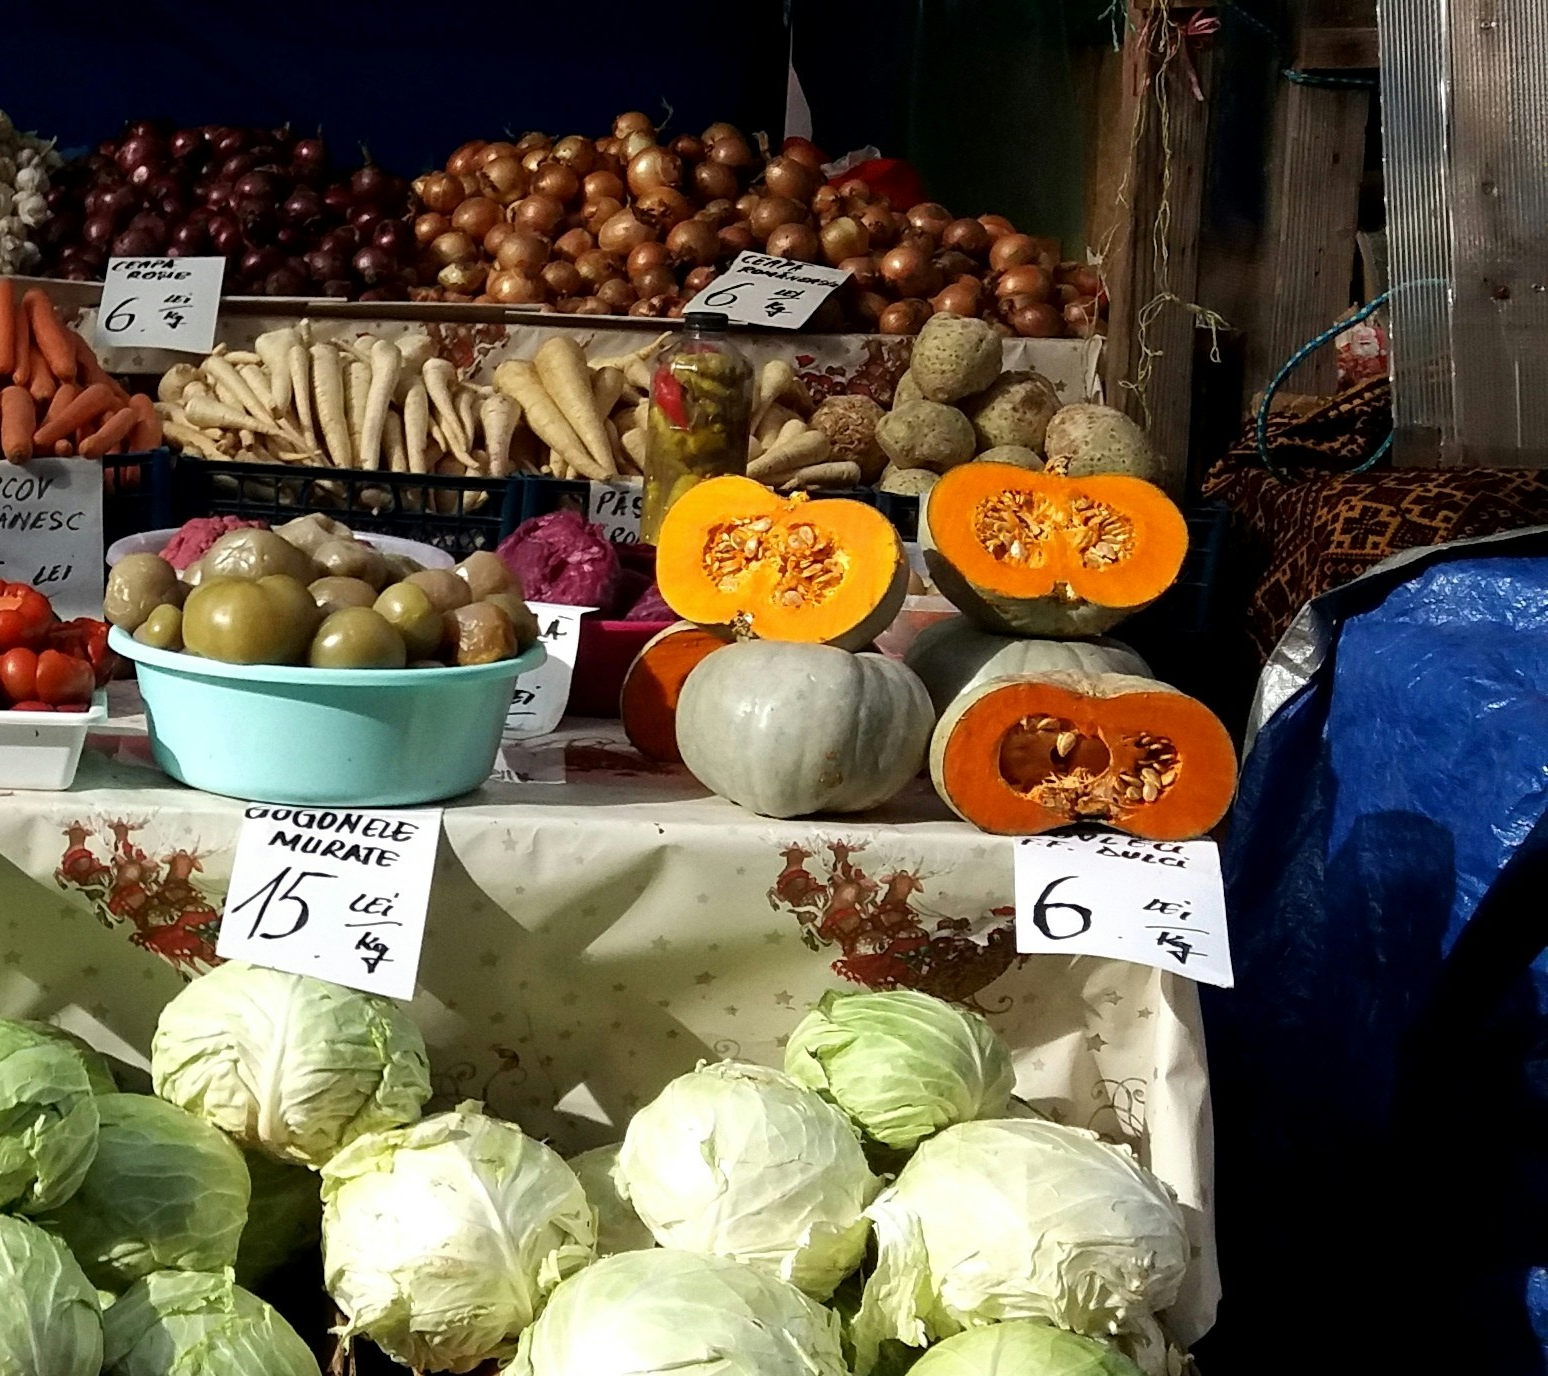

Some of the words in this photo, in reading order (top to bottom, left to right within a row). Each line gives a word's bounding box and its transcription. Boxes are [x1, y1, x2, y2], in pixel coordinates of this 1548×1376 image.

[244, 805, 420, 842] GOGONELE
[268, 830, 401, 867] MURATE
[231, 866, 339, 940] 15
